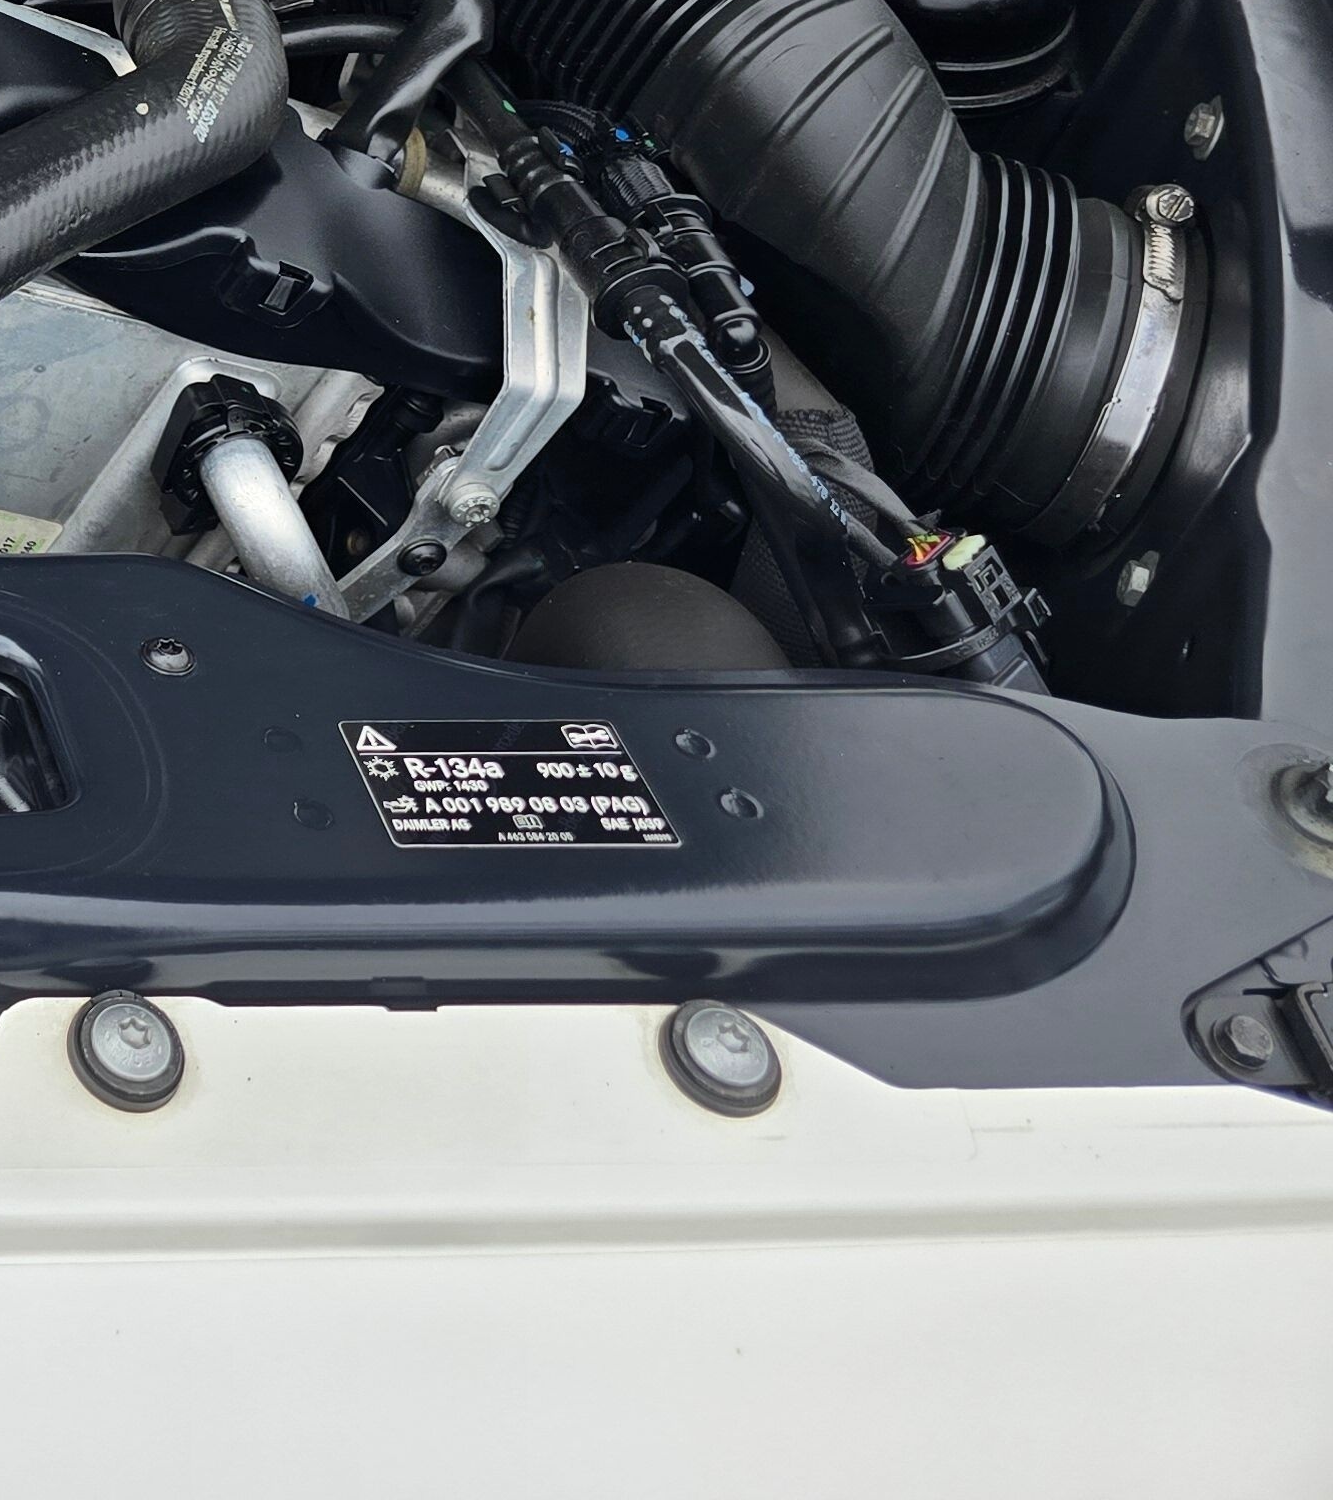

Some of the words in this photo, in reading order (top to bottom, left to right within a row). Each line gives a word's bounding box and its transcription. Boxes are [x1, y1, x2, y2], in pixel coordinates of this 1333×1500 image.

[402, 757, 505, 780] R-134a
[536, 762, 576, 778] 900
[592, 762, 616, 778] 10
[619, 764, 638, 782] g
[453, 780, 490, 792] 1430
[425, 797, 442, 813] A
[442, 797, 483, 813] 001
[485, 797, 526, 814] 989
[528, 796, 559, 814] 08
[559, 796, 590, 814] 03
[590, 795, 651, 816] (PAG)
[392, 818, 451, 832] DAIMLER
[451, 818, 473, 832] AG
[599, 817, 631, 831] SAE
[498, 831, 507, 842] A
[506, 831, 524, 842] 463
[545, 831, 560, 842] 20
